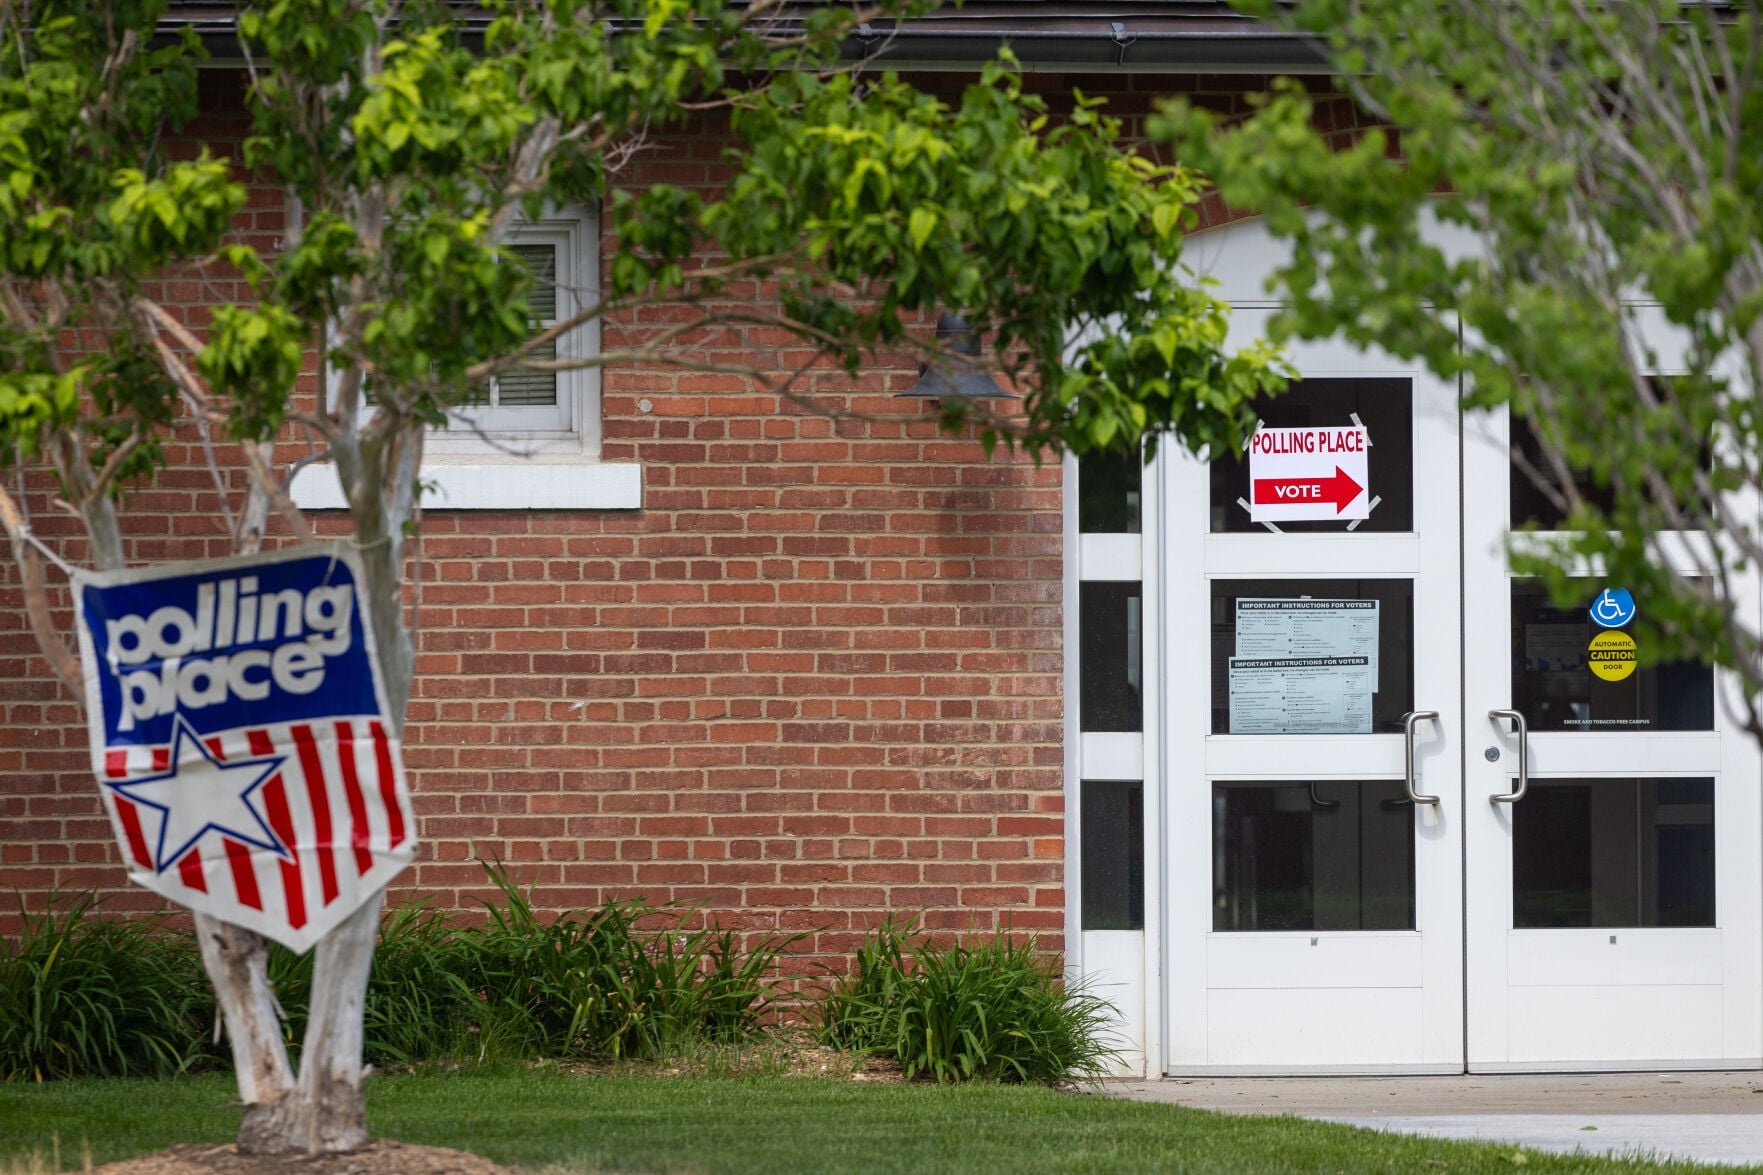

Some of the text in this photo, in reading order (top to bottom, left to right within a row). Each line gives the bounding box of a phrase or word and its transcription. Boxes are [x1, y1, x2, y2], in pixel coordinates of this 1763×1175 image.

[1253, 431, 1363, 454] POLLING PLACE
[1275, 485, 1321, 498] VOTE
[106, 576, 353, 675] polling
[1274, 659, 1323, 667] INSTRUCTIONS
[1590, 651, 1636, 660] CAUTION
[117, 641, 325, 732] place
